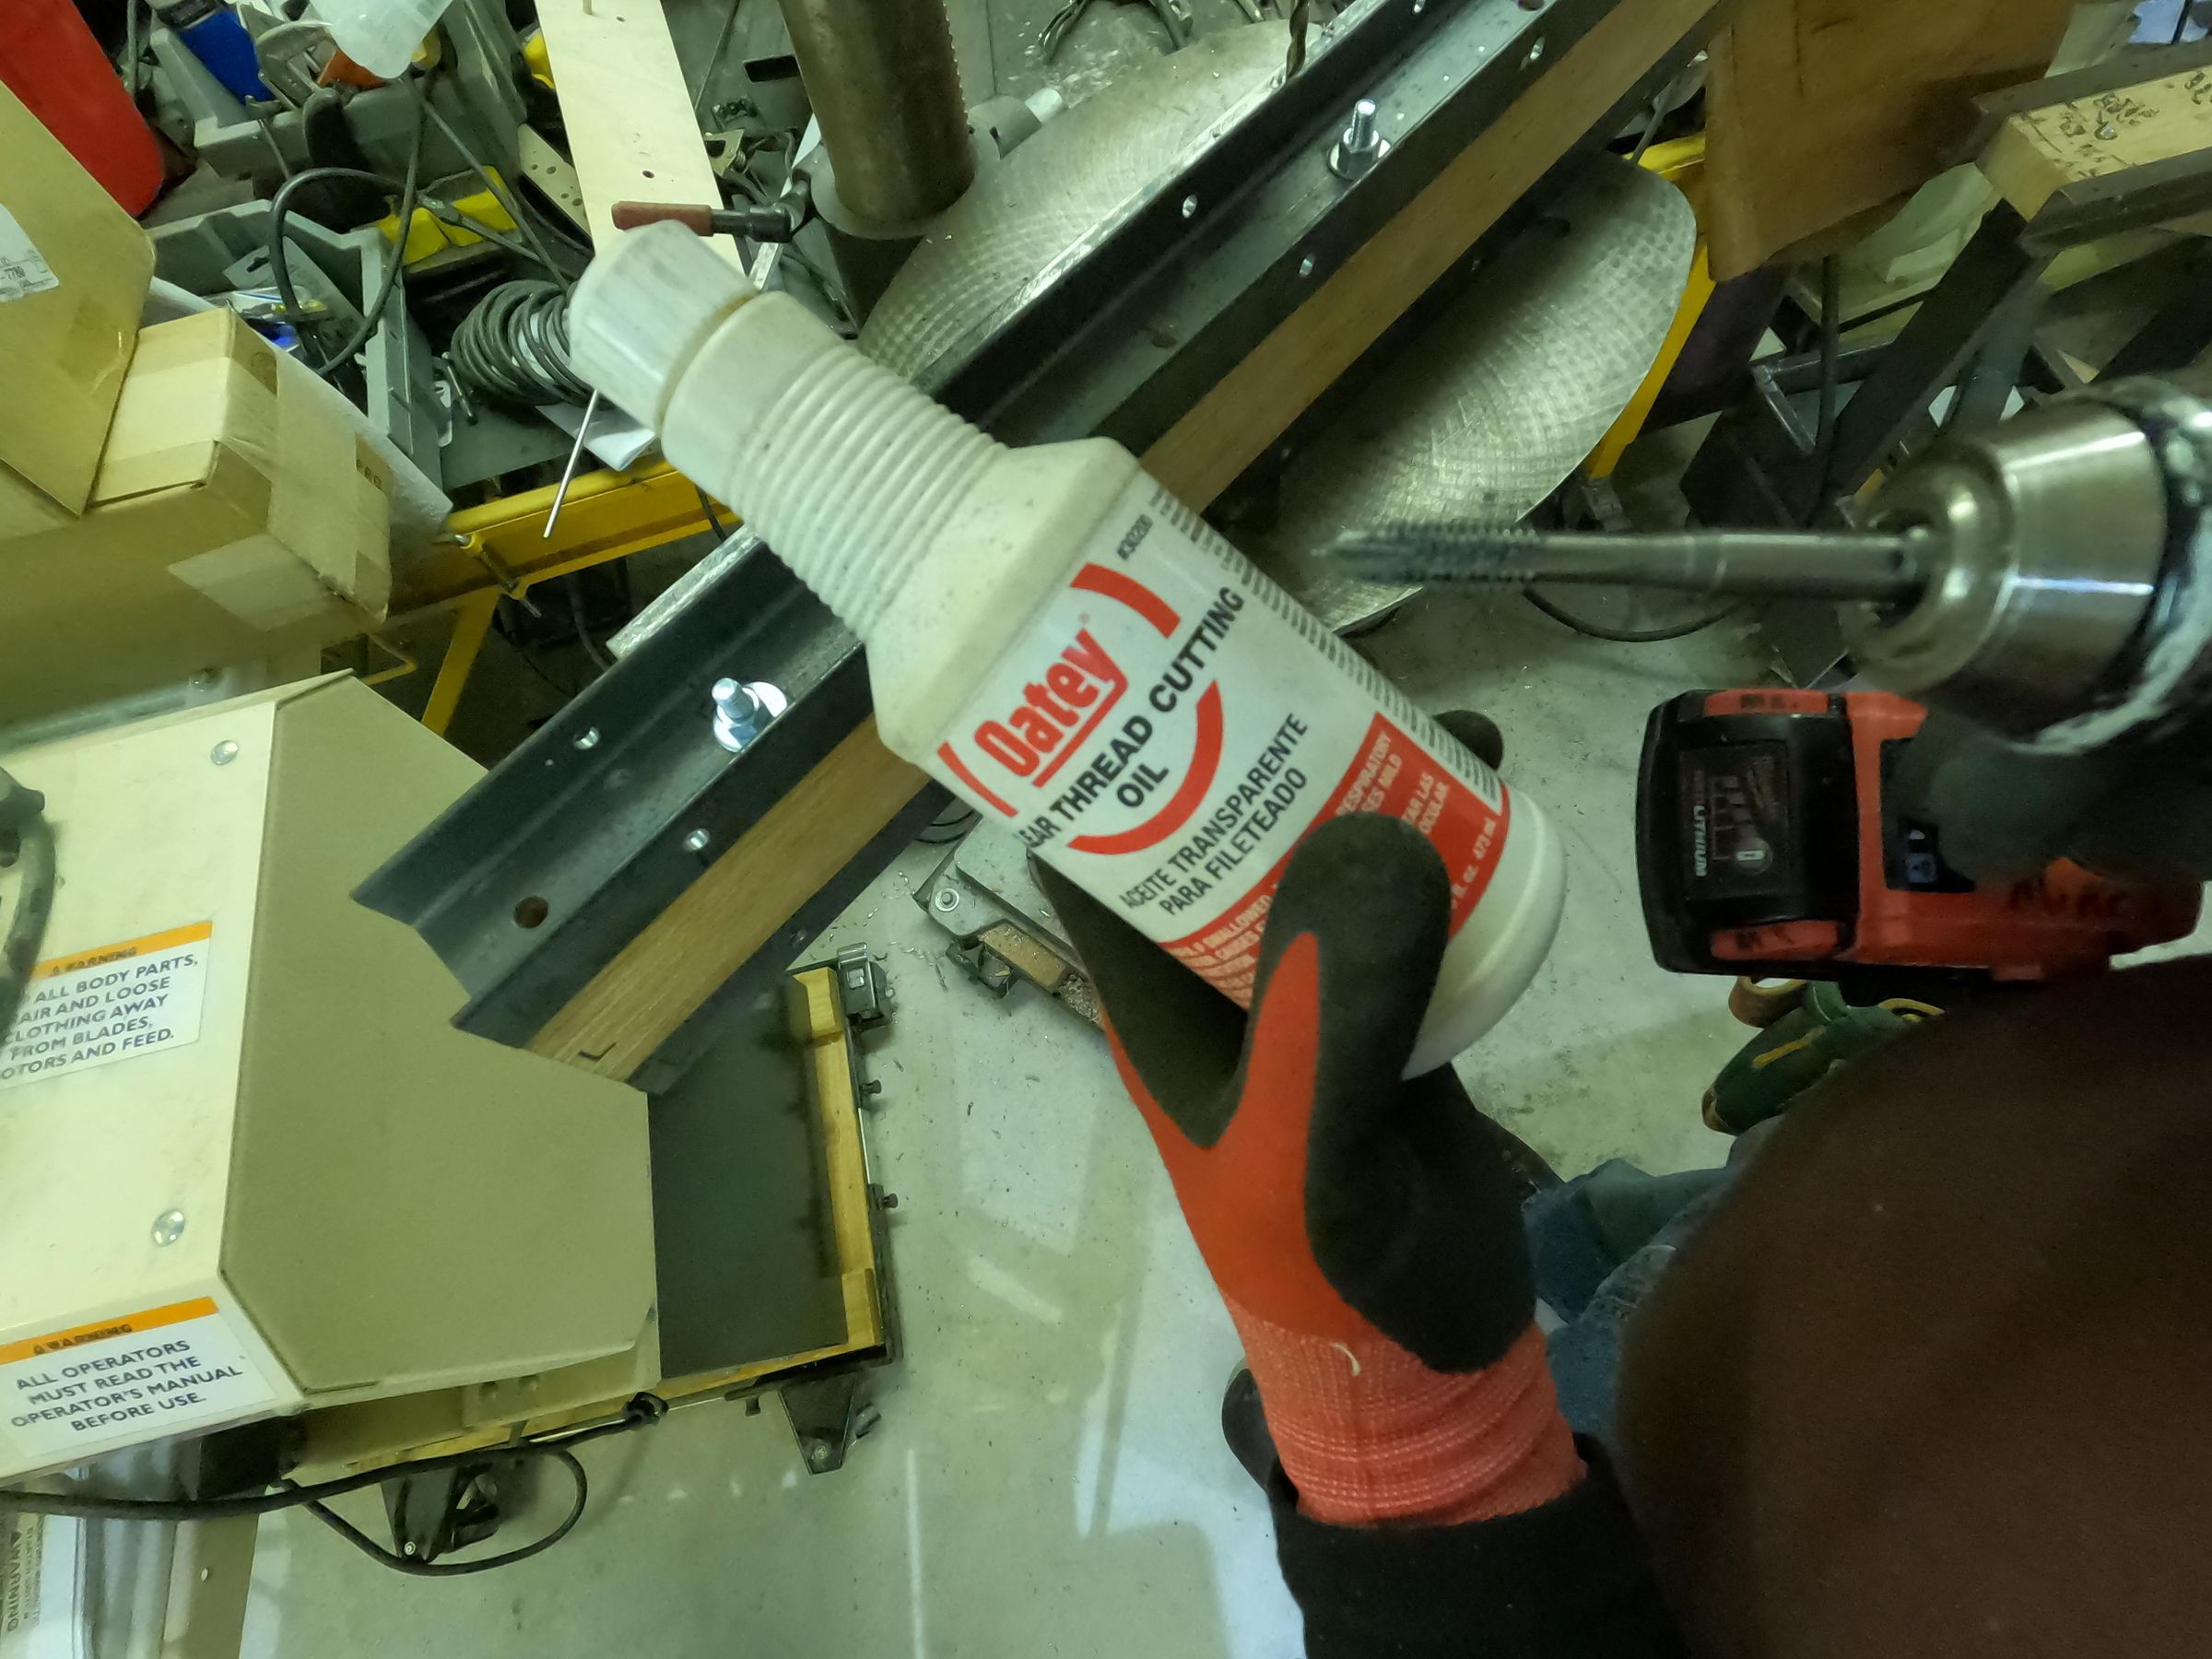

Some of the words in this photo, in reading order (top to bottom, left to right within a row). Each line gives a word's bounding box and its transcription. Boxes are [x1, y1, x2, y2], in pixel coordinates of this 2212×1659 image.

[973, 628, 1129, 782] Oatey
[1050, 715, 1154, 821] THREAD
[1148, 586, 1245, 713] CUTTING
[1116, 763, 1170, 808] OIL
[1119, 868, 1177, 909] ACEITE
[1167, 712, 1309, 874] TRANSPARENTE
[1159, 877, 1213, 916] PARA
[1204, 767, 1308, 881] FILETEADO
[15, 1006, 52, 1026] AIR
[55, 994, 100, 1016] AND
[105, 976, 171, 1004] LOOSE
[33, 985, 70, 1004] ALL
[76, 970, 130, 994] BODY
[135, 954, 199, 979] PARTS,
[110, 994, 170, 1019] AWAY
[0, 1053, 68, 1080] OTORS
[70, 1042, 117, 1064] AND
[122, 1028, 175, 1052] FEED.
[16, 1372, 60, 1391] ALL
[62, 1339, 192, 1380] OPERATORS
[28, 1382, 88, 1406] MUST
[93, 1367, 155, 1390] READ
[155, 1356, 202, 1375] THE
[11, 1388, 145, 1429] OPERATOR'S
[147, 1365, 244, 1395] MANUAL
[70, 1404, 156, 1432] BEFORE
